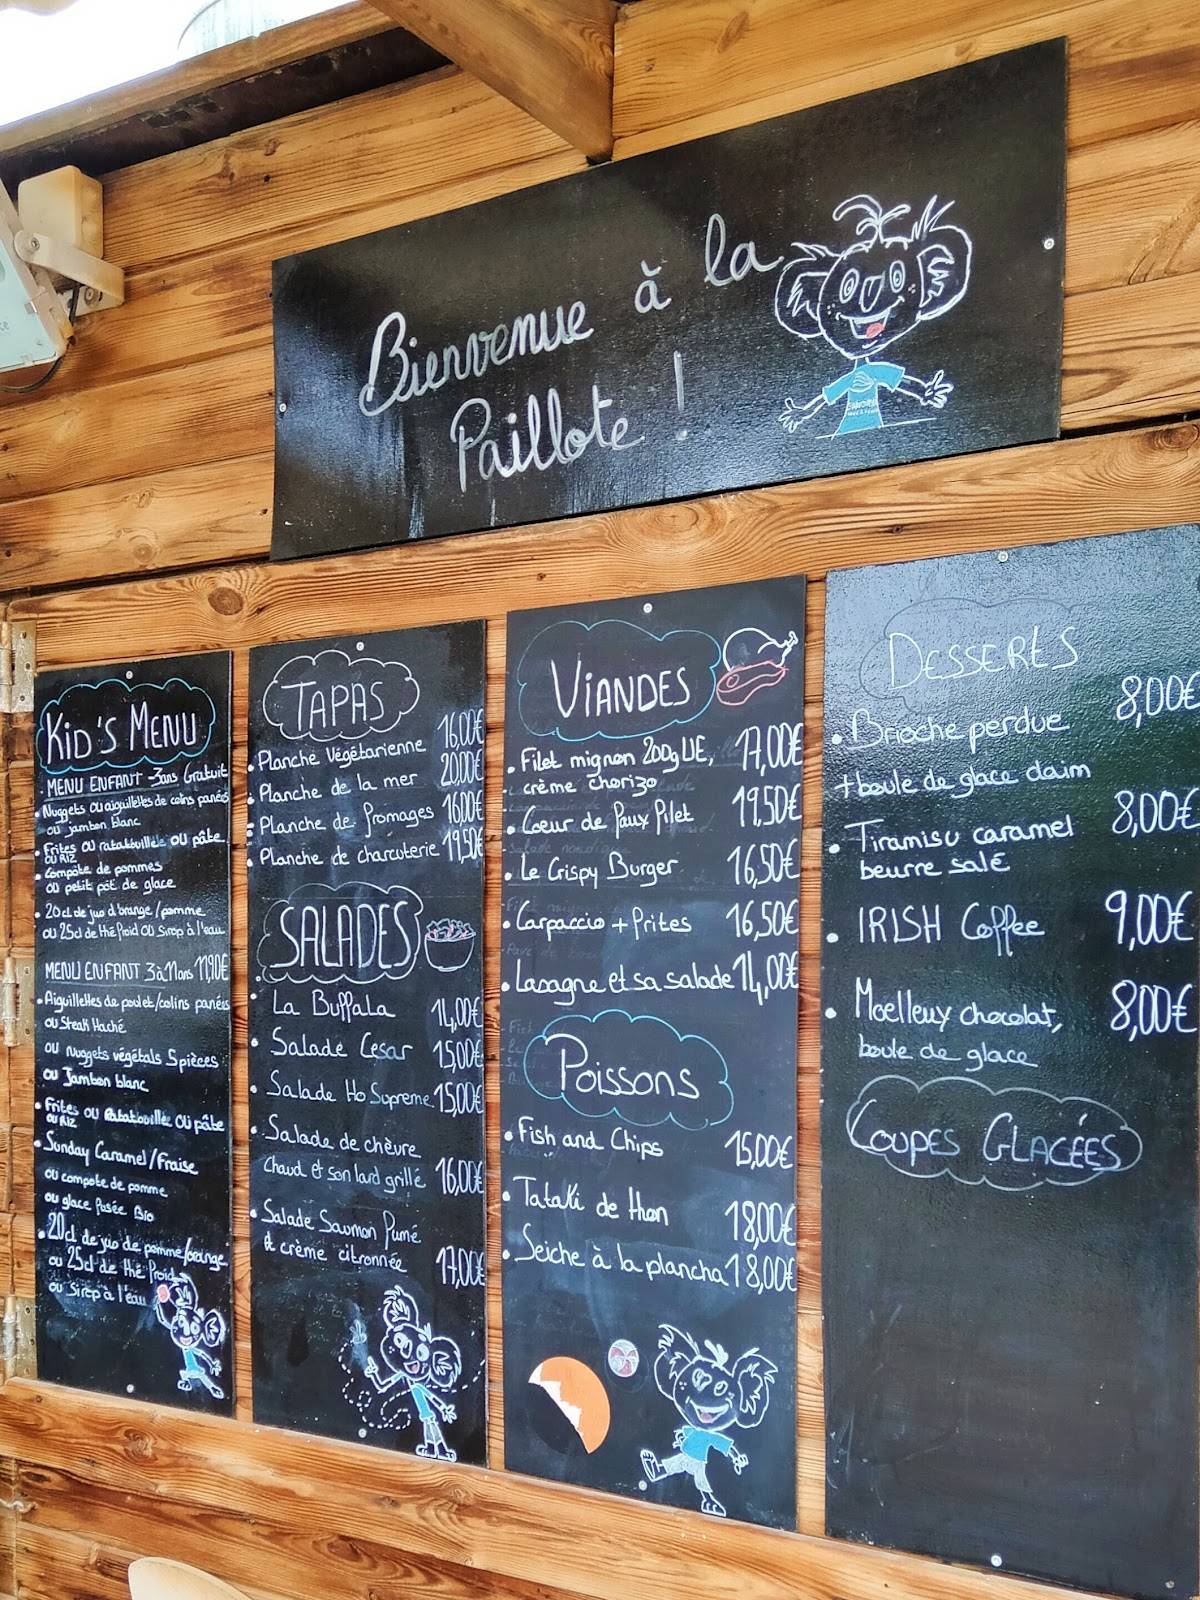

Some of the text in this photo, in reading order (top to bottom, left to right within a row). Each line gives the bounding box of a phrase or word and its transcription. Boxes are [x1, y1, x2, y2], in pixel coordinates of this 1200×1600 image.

[358, 300, 594, 417] Bienvenue
[704, 213, 784, 286] la
[450, 385, 645, 493] Paillote
[130, 701, 197, 750] MENU
[281, 681, 385, 731] TAPAS
[848, 672, 1200, 753] Brioche perdue 8,00€
[258, 750, 320, 771] Planche
[437, 709, 485, 751] 16,00€
[521, 723, 803, 777] Filet mignon 17,00€
[47, 762, 228, 798] MENU ENFANT Gratuit
[260, 748, 484, 803] Planche de la mer 20,00€
[523, 778, 577, 795] crème
[589, 775, 658, 797] chorizo
[923, 768, 956, 791] de
[952, 766, 1019, 799] glace
[1026, 761, 1091, 782] daim
[43, 804, 86, 824] Nuggets
[155, 794, 167, 807] de
[64, 816, 141, 838] jambon blanc
[260, 815, 326, 835] Planche
[333, 812, 355, 830] de
[442, 790, 484, 827] 16,00€
[581, 812, 608, 831] de
[732, 783, 803, 828] 19,50€
[844, 788, 1200, 853] Tiramisu caramel 8,00€
[43, 828, 225, 855] Frites pâte
[260, 847, 323, 866] Planche
[333, 845, 350, 865] de
[357, 842, 440, 864] charcuterie
[442, 826, 484, 864] 19,50€
[96, 861, 163, 877] de pommes
[521, 839, 801, 889] Le Crispy Burger 16,50€
[860, 860, 942, 880] beurre
[65, 876, 176, 896] petit de glace
[74, 905, 104, 924] de jus
[84, 920, 226, 939] de l'eau
[270, 901, 412, 969] SALADES
[516, 900, 605, 942] Carpaccio
[725, 899, 799, 942] 16,50€
[859, 904, 941, 943] IRISH
[1105, 889, 1193, 950] 9,00€
[45, 963, 140, 980] MENU ENFANT
[515, 950, 799, 1006] Lasagne et sa salade 14,00€
[104, 993, 119, 1007] de
[273, 990, 300, 1015] La
[431, 997, 483, 1033] 14,00€
[855, 977, 951, 1033] Moelleux
[1110, 980, 1198, 1042] 8,00€
[93, 1018, 127, 1033] Haché
[66, 1046, 161, 1068] Nuggets végétals
[271, 1027, 347, 1057] Salade
[433, 1038, 484, 1073] 15,00€
[859, 1034, 1038, 1072] boule de glace
[62, 1066, 149, 1092] Jambon blanc
[266, 1070, 336, 1102] Salade
[434, 1081, 484, 1117] 15,00€
[45, 1097, 225, 1134] Frites pâte
[265, 1114, 421, 1158] Salade de chèvre
[43, 1130, 90, 1166] Sunday
[519, 1116, 794, 1170] Fish and Chips 15,00€
[61, 1173, 169, 1198] compote de pomme
[327, 1167, 352, 1182] son
[354, 1164, 381, 1185] lard
[384, 1166, 427, 1193] grillé
[435, 1157, 484, 1196] 16,00€
[62, 1194, 155, 1222] glace Bio
[261, 1198, 315, 1230] Salade
[319, 1209, 377, 1241] Saumon
[596, 1192, 620, 1218] de
[629, 1186, 669, 1226] thon
[725, 1200, 797, 1250] 18,00€
[82, 1229, 141, 1254] de jus de
[514, 1223, 729, 1286] Seiche à la plancha
[99, 1258, 146, 1279] de thé
[279, 1238, 486, 1289] crème citronnée 17,00€
